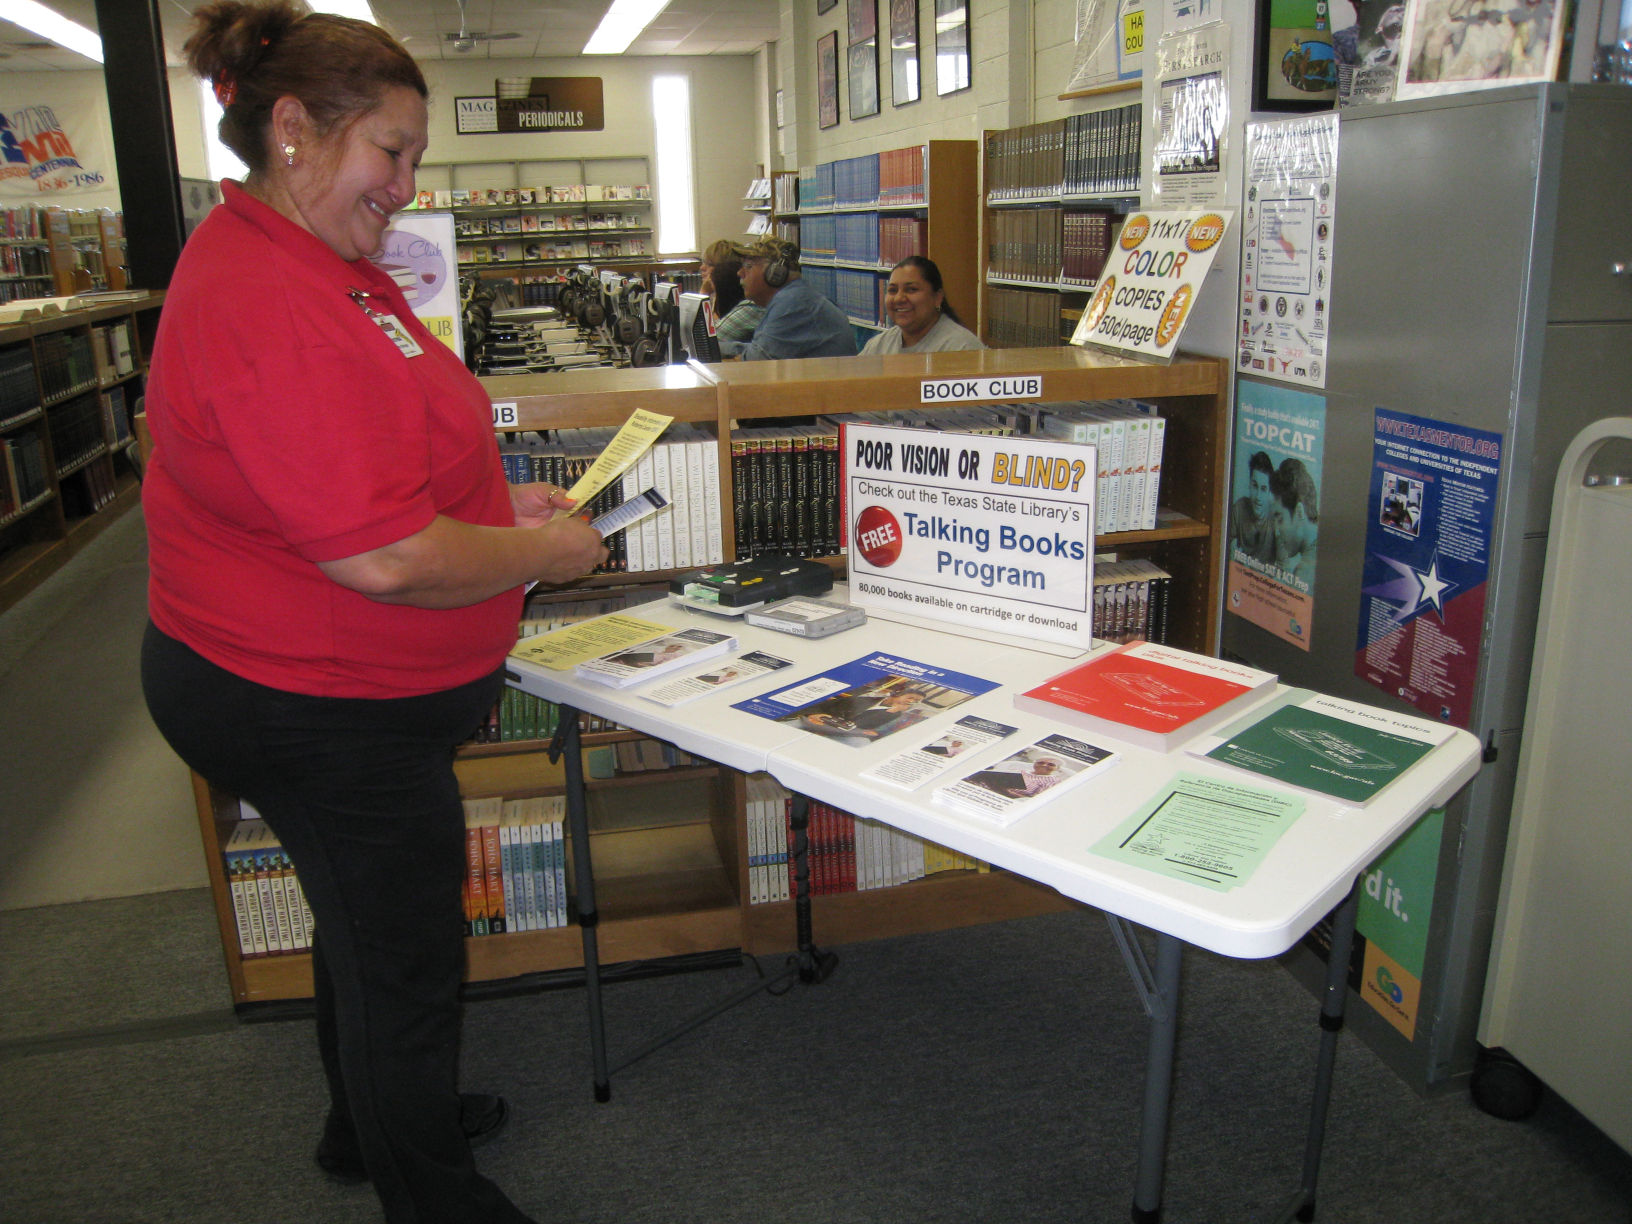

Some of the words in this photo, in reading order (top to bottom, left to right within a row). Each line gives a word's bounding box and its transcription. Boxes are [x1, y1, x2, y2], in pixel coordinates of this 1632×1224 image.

[1131, 17, 1144, 30] HA
[1125, 35, 1143, 50] COU
[518, 111, 584, 127] PERIODICALS
[1125, 226, 1146, 240] NEW
[1151, 219, 1192, 240] 11x17
[1190, 226, 1220, 241] NEW
[407, 240, 443, 258] Club
[1124, 249, 1189, 279] COLOR
[1115, 286, 1166, 312] COPIES
[1162, 292, 1188, 339] NEW
[1098, 315, 1154, 347] 50¢/page
[923, 382, 979, 399] BOOK
[989, 379, 1039, 396] CLUB
[1243, 418, 1316, 453] TOPCAT
[855, 439, 893, 471] POOR
[901, 443, 950, 478] VISION
[958, 449, 980, 481] OR
[991, 452, 1086, 493] BLIND?
[1385, 448, 1409, 461] COLLEGES
[1409, 453, 1420, 464] AND
[1419, 456, 1455, 473] UNIVERSITIES
[1454, 466, 1463, 475] OF
[1463, 469, 1481, 480] TEXAS
[1387, 441, 1409, 453] INTERNET
[1410, 446, 1440, 461] CONNECTION
[1441, 454, 1449, 463] TO
[1449, 456, 1460, 466] THE
[1459, 458, 1499, 475] INDEPENDENT
[858, 482, 894, 499] Check
[897, 489, 916, 502] out
[919, 489, 938, 504] the
[941, 491, 978, 509] Texas
[982, 496, 1016, 514] State
[1021, 501, 1080, 523] Library's
[860, 523, 897, 552] FREE
[904, 512, 990, 552] Talking
[999, 525, 1085, 560] Books
[937, 551, 1046, 590] Program
[858, 582, 886, 597] 80,000
[887, 587, 913, 602] books
[915, 593, 954, 609] available
[956, 602, 968, 611] on
[970, 604, 1012, 620] cartridge
[1015, 613, 1026, 622] or
[1028, 614, 1078, 631] download
[1316, 699, 1356, 715] talking
[1358, 711, 1388, 723] book
[1392, 721, 1431, 735] topics
[470, 840, 479, 865] JOHN
[487, 838, 496, 864] JOHN
[472, 870, 480, 894] HART
[489, 867, 498, 892] HART
[236, 894, 244, 914] WORST
[249, 893, 258, 912] WORST
[274, 891, 284, 910] WORST
[288, 888, 297, 907] WORST
[1384, 877, 1410, 923] it.
[239, 915, 247, 931] HARD
[252, 914, 260, 930] HARD
[262, 891, 271, 910] WORST
[268, 929, 276, 942] TIME
[278, 911, 286, 927] HARD
[291, 909, 300, 925] HARD
[242, 933, 250, 946] TIME
[255, 932, 263, 944] TIME
[294, 927, 303, 940] TIME
